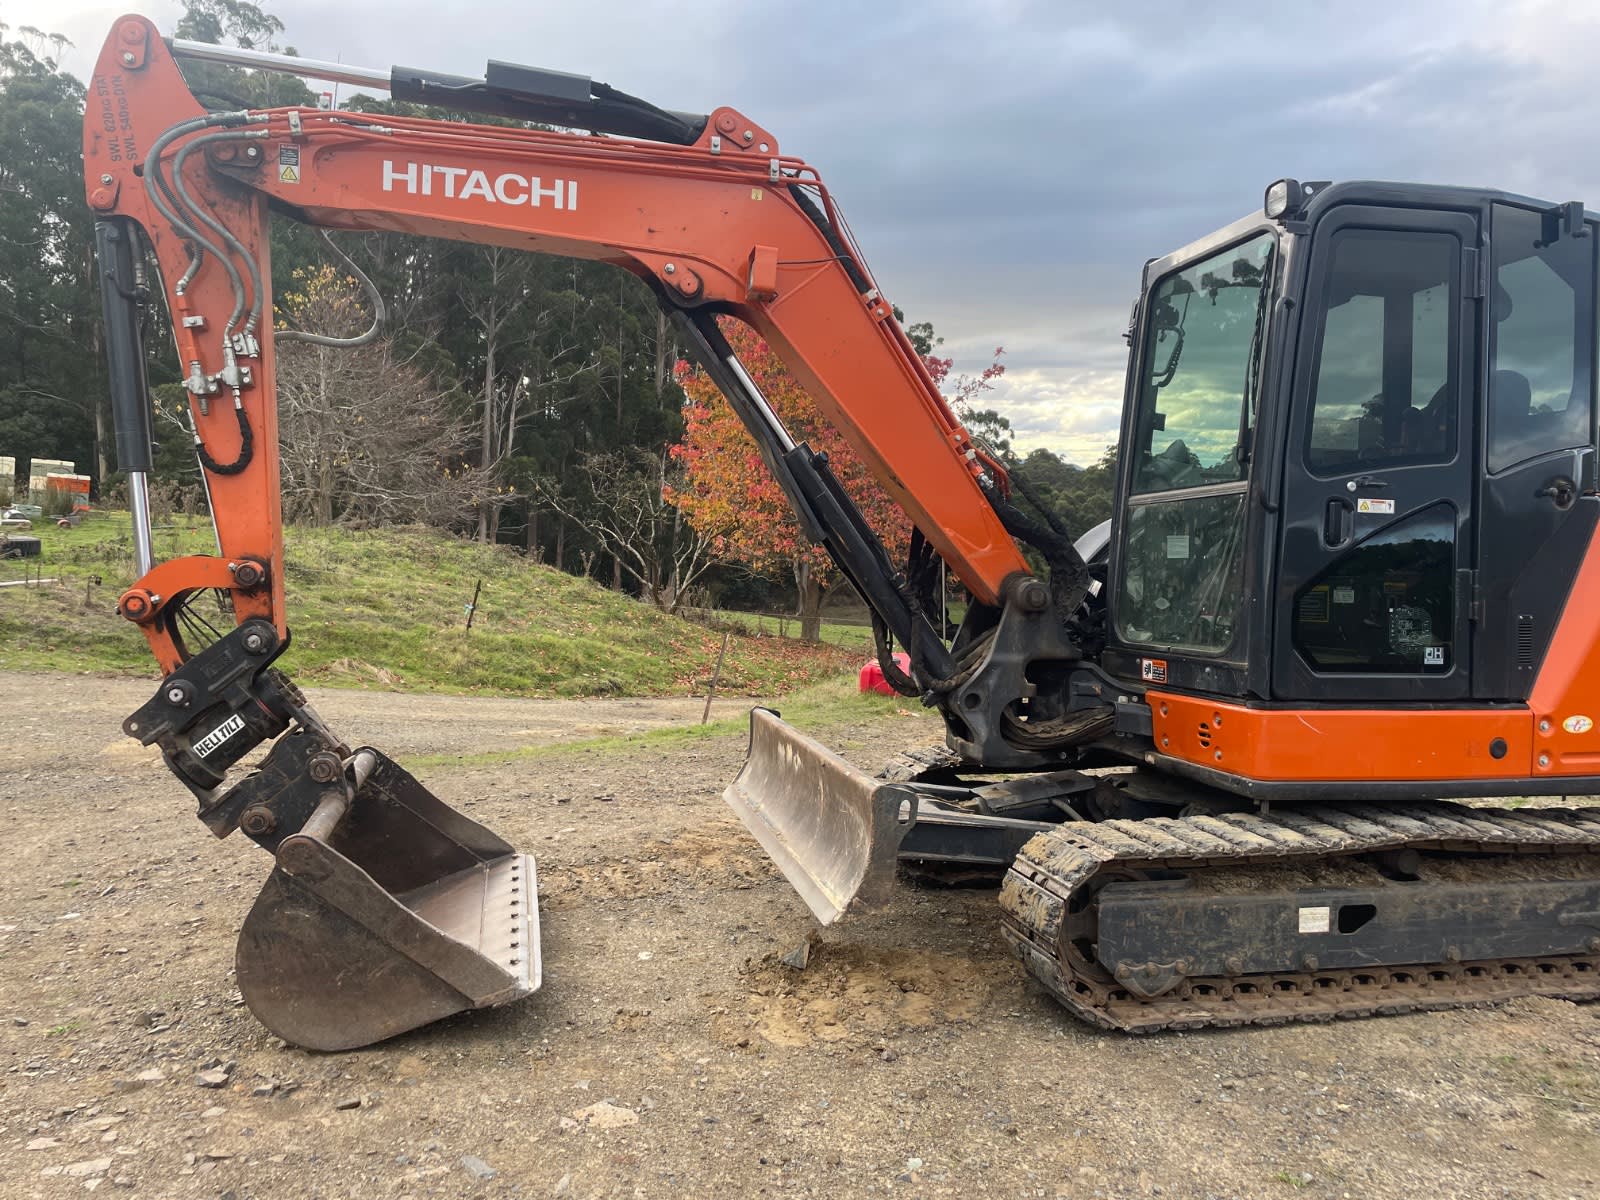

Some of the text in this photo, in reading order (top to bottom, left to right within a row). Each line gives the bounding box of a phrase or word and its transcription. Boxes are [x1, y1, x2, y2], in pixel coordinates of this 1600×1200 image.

[95, 74, 108, 96] STAT
[112, 74, 124, 95] DYN
[107, 136, 121, 161] SWL
[124, 134, 137, 160] SWL
[383, 160, 577, 210] HITACHI
